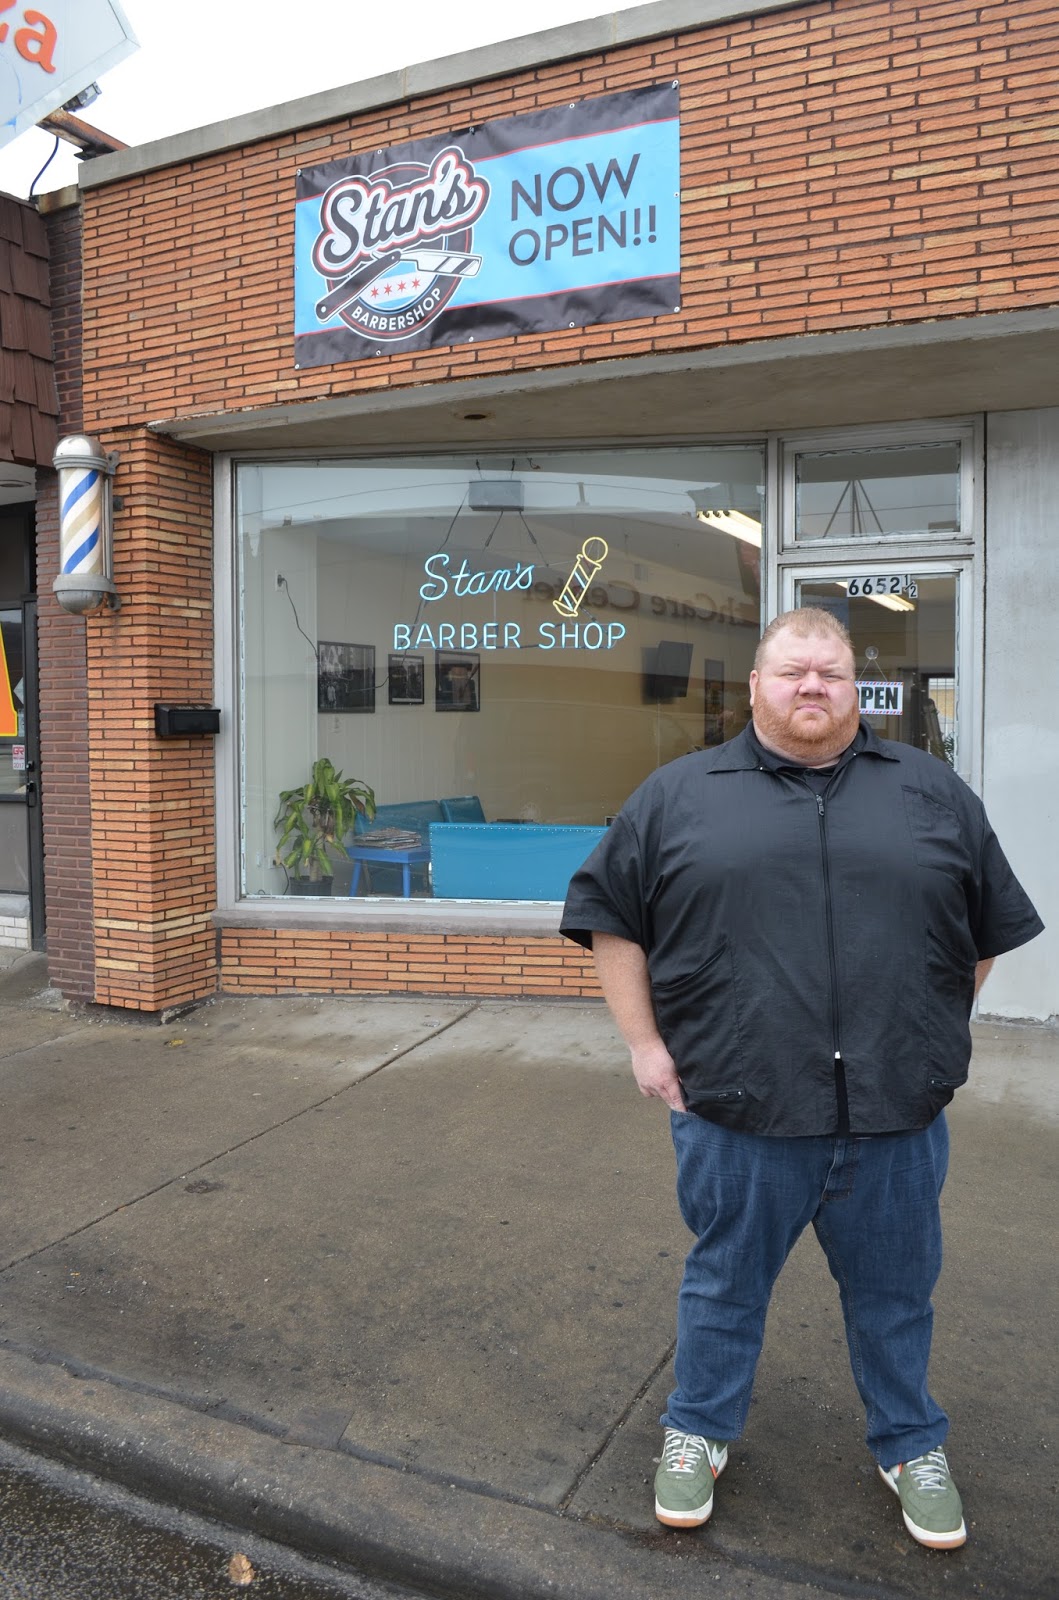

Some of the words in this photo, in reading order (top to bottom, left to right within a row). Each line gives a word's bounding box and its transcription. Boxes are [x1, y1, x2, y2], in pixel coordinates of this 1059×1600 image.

[511, 153, 641, 221] NOW
[322, 159, 478, 263] Stan's
[508, 205, 657, 266] OPEN!!
[351, 287, 441, 331] BARBERSHOP
[420, 553, 535, 601] Stan's
[848, 576, 901, 596] 6652
[393, 623, 521, 650] BARBER
[538, 622, 626, 650] SHOP
[857, 686, 898, 709] PEN
